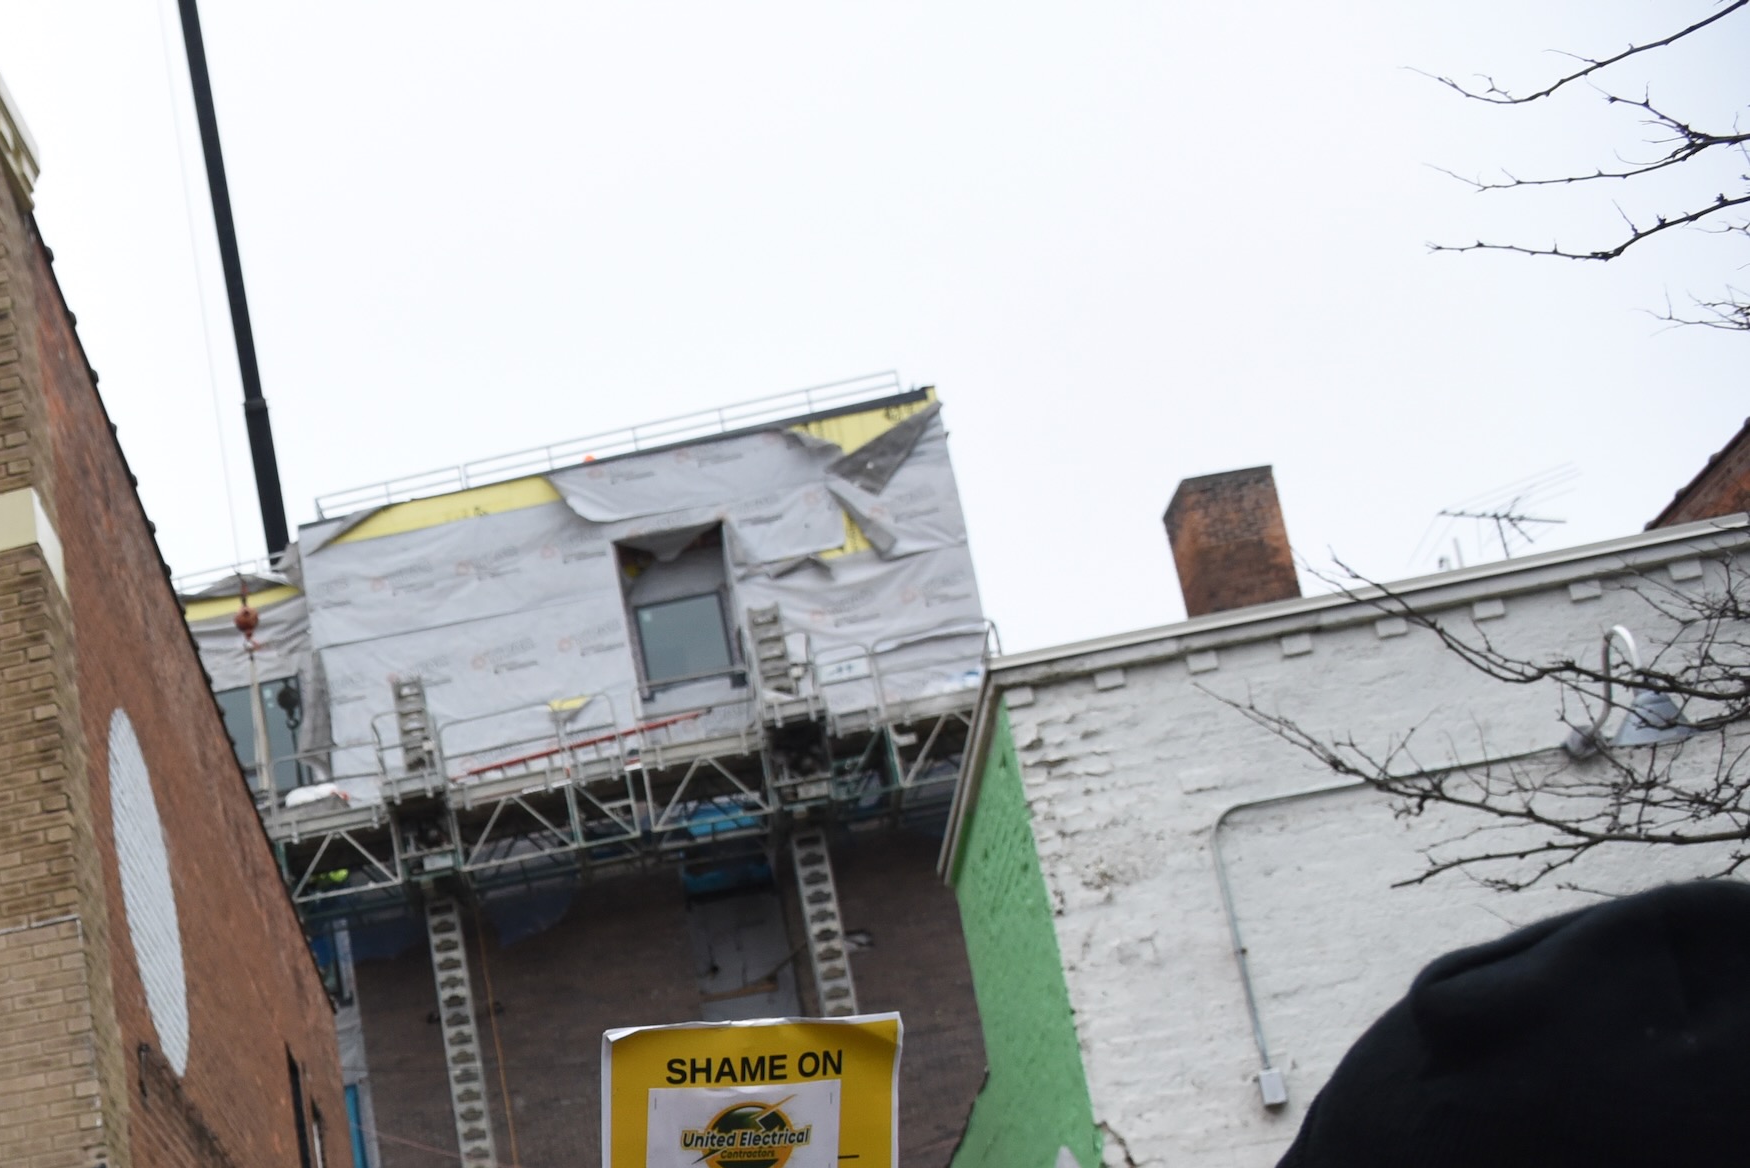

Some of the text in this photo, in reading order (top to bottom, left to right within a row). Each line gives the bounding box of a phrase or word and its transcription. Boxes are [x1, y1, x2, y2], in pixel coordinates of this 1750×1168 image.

[666, 1050, 843, 1084] SHAME ON
[683, 1128, 810, 1147] United Electrical
[720, 1149, 775, 1160] Contractors
